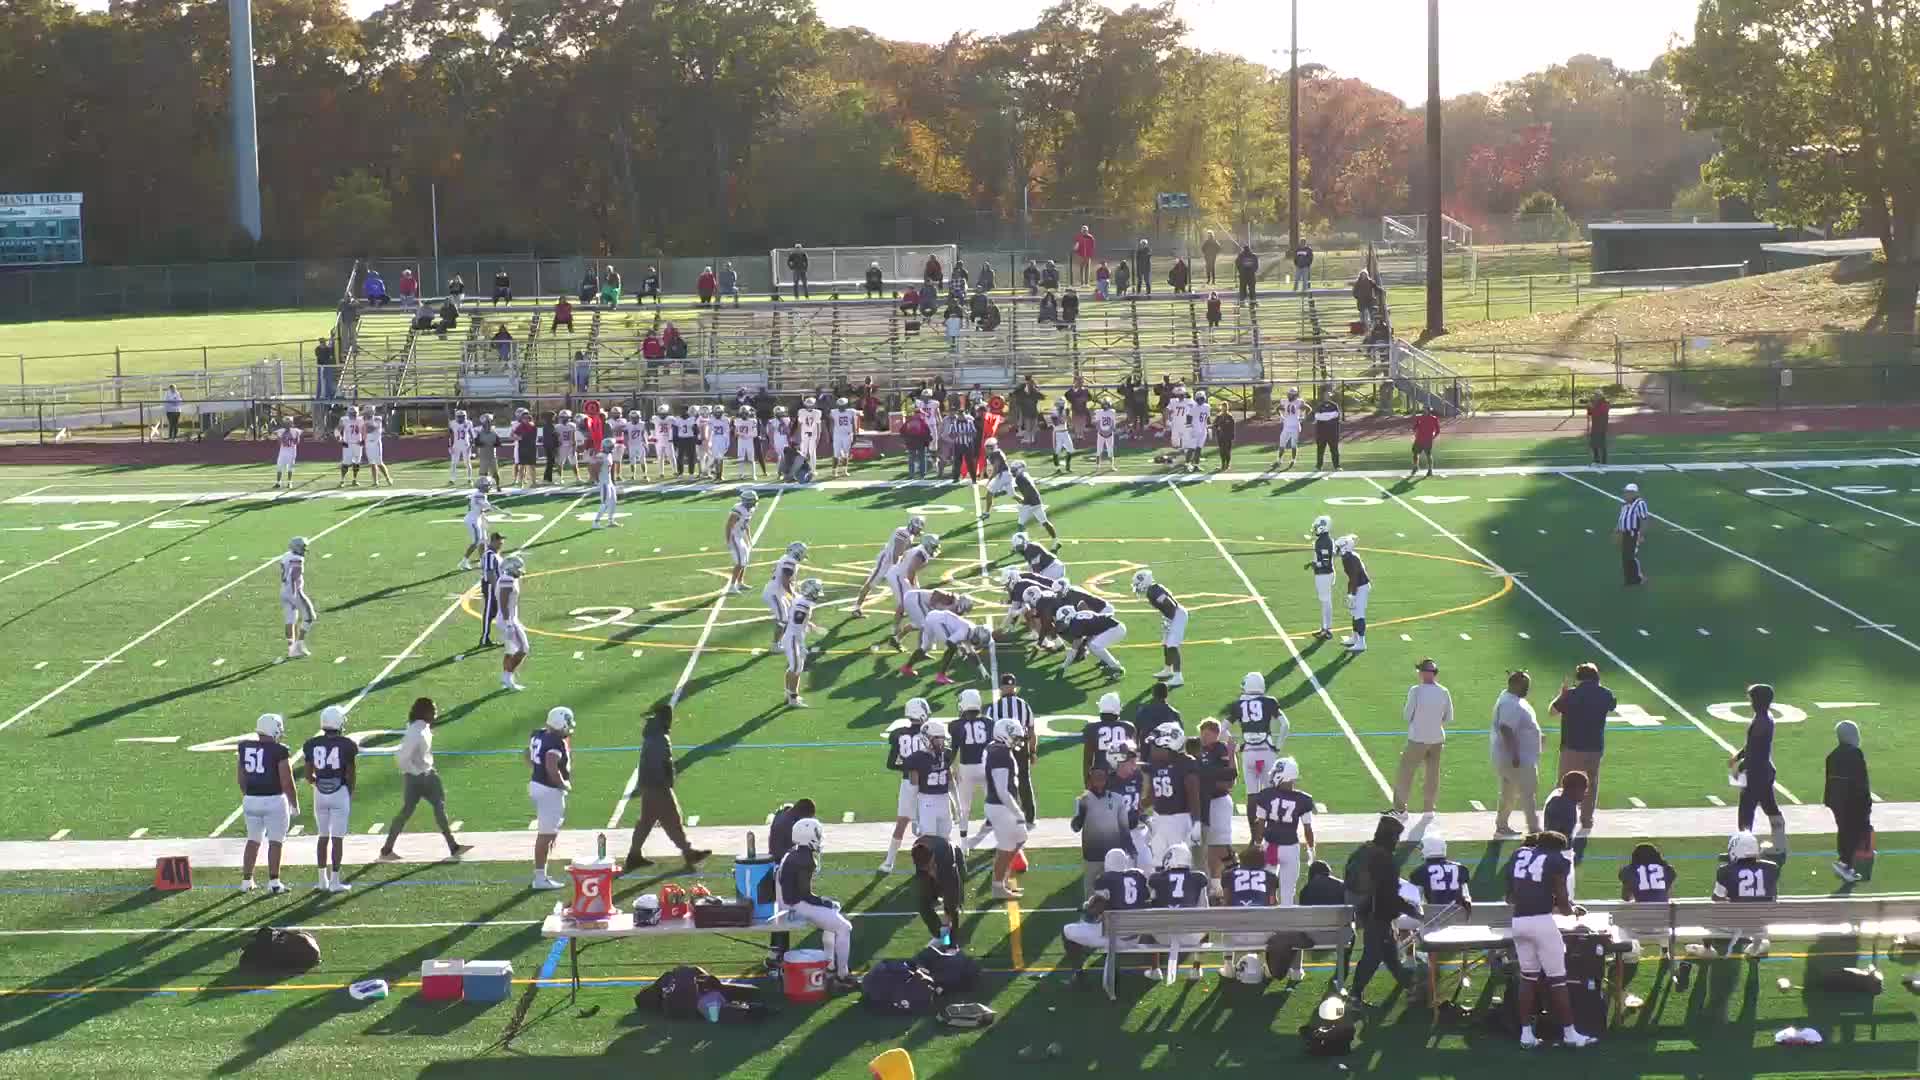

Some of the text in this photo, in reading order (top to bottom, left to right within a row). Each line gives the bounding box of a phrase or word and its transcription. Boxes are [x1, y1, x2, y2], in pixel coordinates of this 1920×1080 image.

[1240, 700, 1264, 723] 19
[963, 721, 987, 745] 16
[1097, 726, 1127, 752] 20
[243, 748, 265, 774] 51
[313, 746, 341, 770] 84
[1268, 797, 1297, 823] 17
[1427, 864, 1459, 891] 27
[1512, 850, 1547, 882] 24
[1636, 864, 1666, 890] 12
[581, 878, 600, 897] G
[1123, 877, 1138, 905] 6
[1168, 873, 1186, 898] 7
[1233, 869, 1267, 893] 22
[1737, 869, 1766, 897] 21
[810, 970, 824, 986] G
